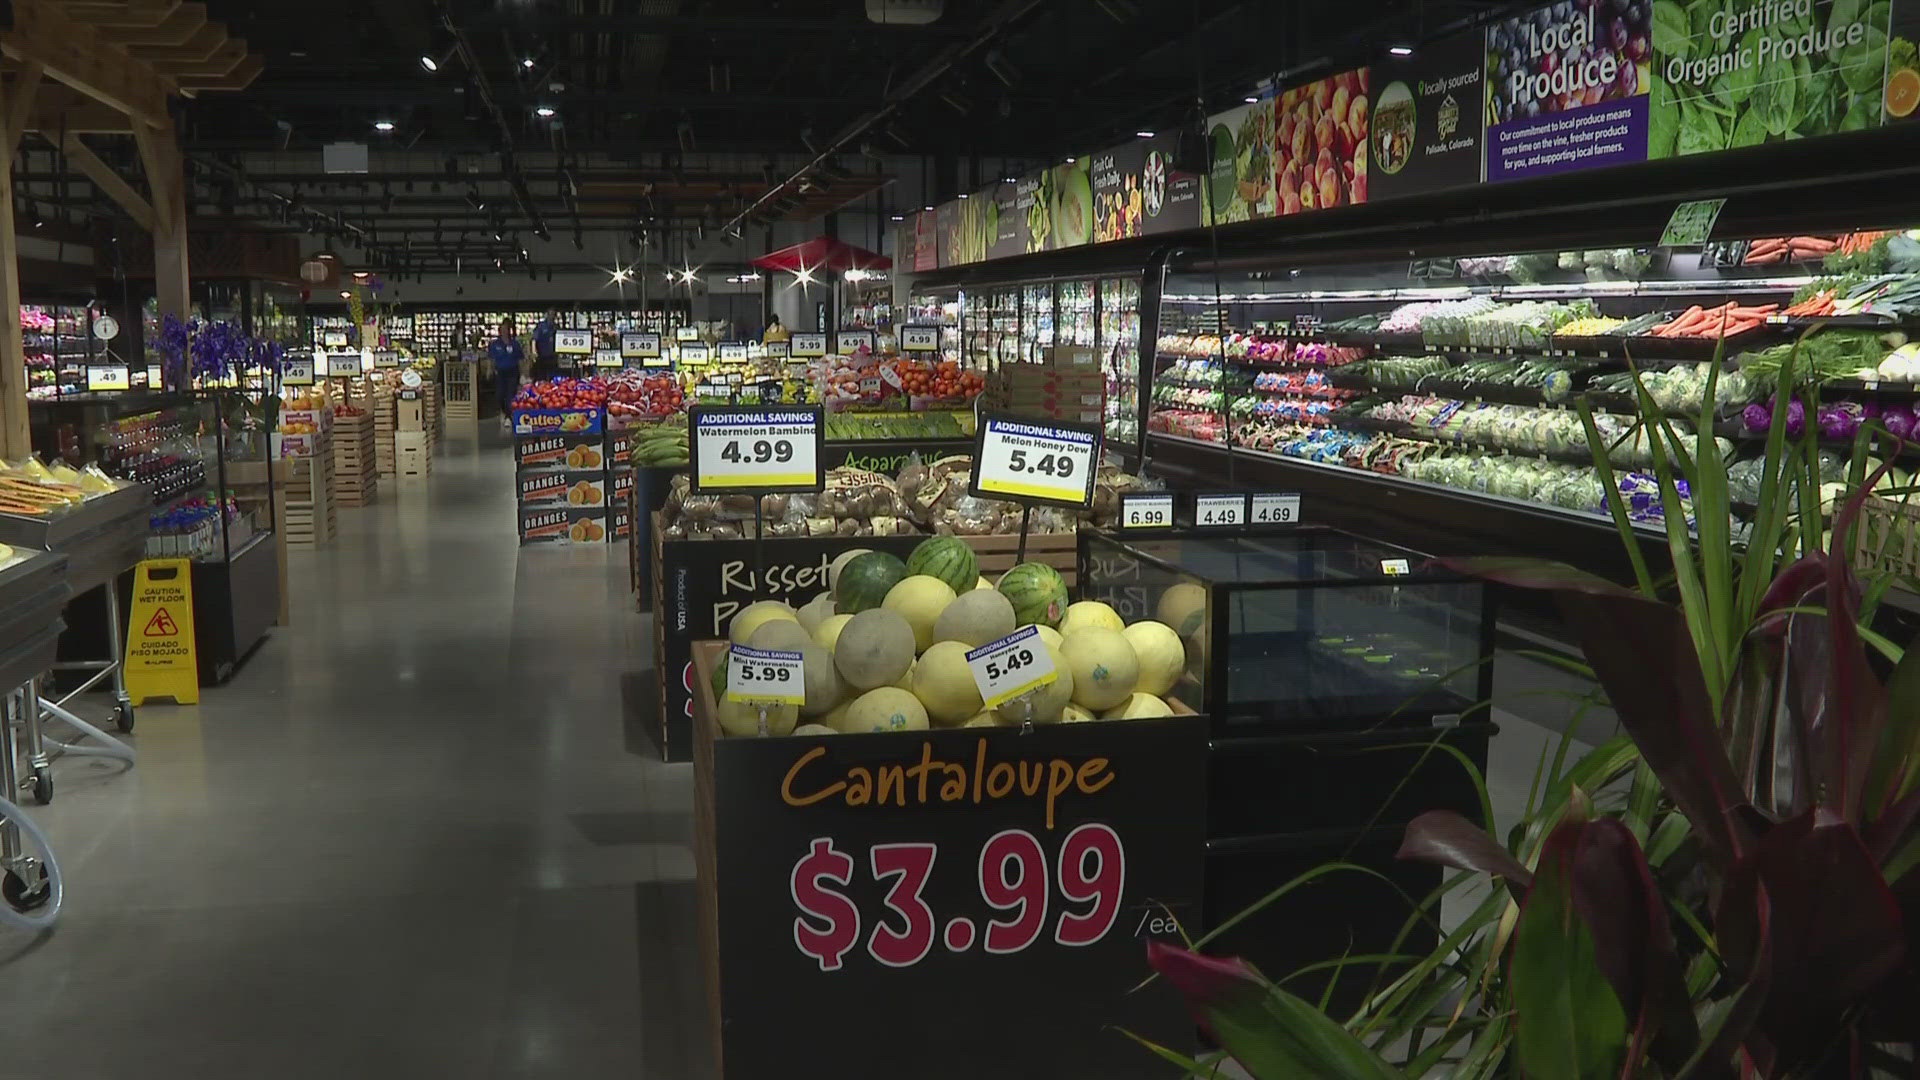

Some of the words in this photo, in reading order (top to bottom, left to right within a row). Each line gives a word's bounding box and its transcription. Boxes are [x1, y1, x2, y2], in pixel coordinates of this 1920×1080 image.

[1709, 0, 1811, 40] Certified
[1530, 5, 1594, 58] Local
[1666, 43, 1752, 86] Organic
[1757, 21, 1864, 66] Produce
[1424, 77, 1448, 96] locally
[1448, 66, 1479, 89] sourced
[1511, 56, 1617, 105] Produce
[1500, 131, 1512, 141] Our
[1512, 123, 1551, 140] commitment
[1551, 121, 1558, 131] to
[1559, 117, 1575, 131] local
[1575, 113, 1606, 131] produce
[1606, 108, 1632, 122] means
[1448, 137, 1474, 151] Colorado
[1502, 144, 1518, 155] more
[1518, 140, 1532, 153] time
[1533, 141, 1541, 151] on
[1542, 137, 1552, 149] the
[1553, 134, 1569, 146] vine,
[1570, 129, 1594, 144] fresher
[1595, 124, 1628, 140] products
[1104, 155, 1114, 170] Cut
[1504, 159, 1514, 170] for
[1514, 157, 1527, 171] you,
[1528, 154, 1540, 166] and
[1540, 149, 1576, 165] supporting
[1577, 145, 1593, 158] local
[1594, 141, 1624, 156] farmers.
[1094, 175, 1107, 190] Fresh
[562, 338, 584, 346] 6.99
[629, 342, 652, 350] 5.49
[799, 341, 820, 349] 5.99
[843, 339, 865, 347] 4.99
[909, 336, 931, 344] 4.99
[99, 373, 117, 381] .49
[519, 414, 561, 427] Cuties
[700, 413, 767, 424] ADDITIONAL
[767, 412, 814, 423] SAVINGS
[699, 427, 767, 436] Watermelon
[995, 421, 1055, 438] ADDITIONAL
[521, 437, 564, 455] ORANGES
[721, 440, 794, 463] 4.99
[1001, 435, 1032, 447] Melon
[1033, 440, 1066, 453] Honey
[1067, 444, 1089, 454] Dew
[844, 451, 943, 472] Asparaus
[1008, 449, 1074, 478] 5.49
[522, 474, 566, 492] ORANGES
[524, 511, 567, 529] ORANGES
[1131, 511, 1163, 525] 6.99
[1204, 509, 1236, 524] 4.49
[1258, 507, 1290, 522] 4.69
[678, 569, 687, 602] Product
[677, 611, 686, 631] USA
[153, 648, 189, 656] MOJADO
[968, 640, 1008, 660] ADDITIONAL
[1007, 628, 1035, 644] SAVINGS
[989, 645, 1020, 660] Honeydew
[733, 646, 770, 659] ADDITIONAL
[771, 652, 800, 660] SAVINGS
[733, 656, 749, 664] Mini
[749, 659, 799, 668] Watermelons
[986, 650, 1034, 680] 5.49
[741, 665, 791, 682] 5.99
[780, 737, 1116, 830] Cantaloupe
[790, 822, 1126, 972] $3.99
